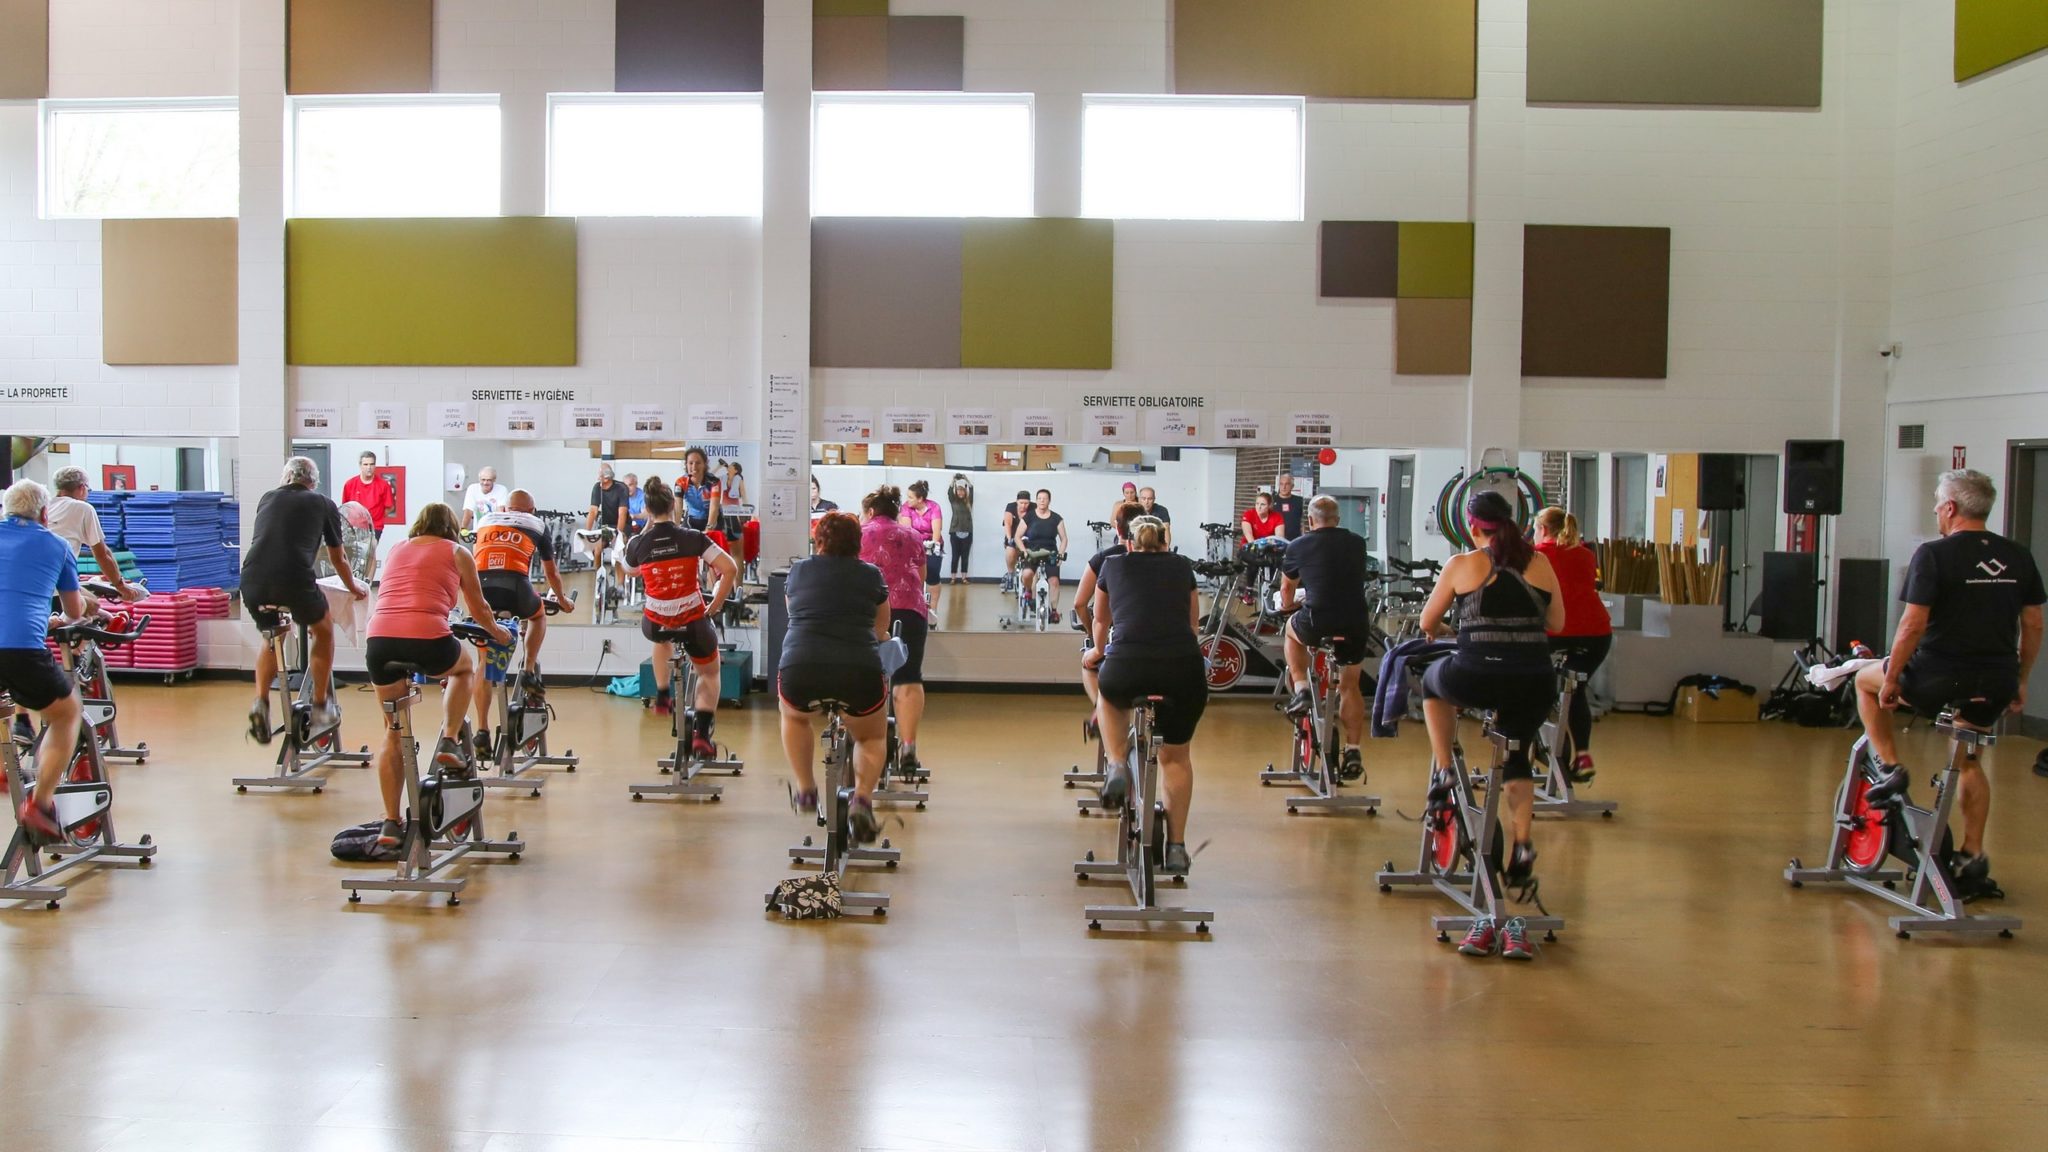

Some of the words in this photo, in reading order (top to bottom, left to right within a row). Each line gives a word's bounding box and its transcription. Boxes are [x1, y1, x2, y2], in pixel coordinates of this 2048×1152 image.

[7, 387, 19, 398] LA
[21, 385, 68, 398] PROPRETÉ
[472, 389, 522, 401] SERVIETTE
[533, 388, 575, 401] HYGIÈNE
[1083, 395, 1136, 407] SERVIETTE
[1138, 396, 1205, 408] OBLIGATOIRE
[704, 445, 739, 457] SERVIETTE
